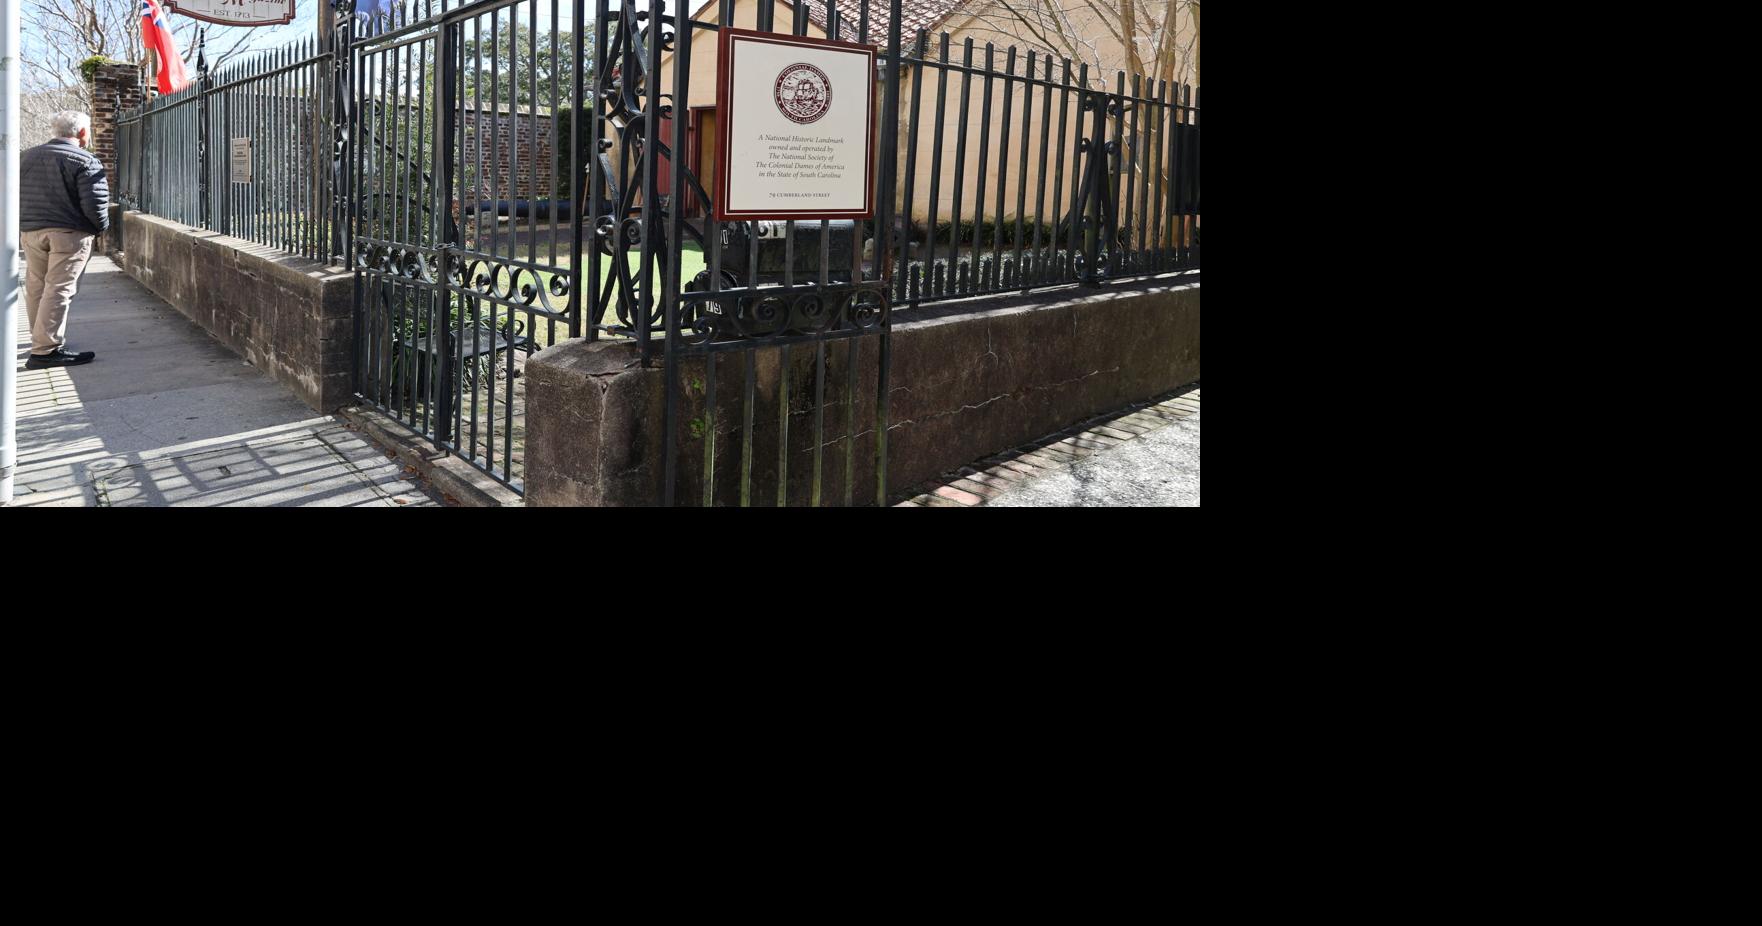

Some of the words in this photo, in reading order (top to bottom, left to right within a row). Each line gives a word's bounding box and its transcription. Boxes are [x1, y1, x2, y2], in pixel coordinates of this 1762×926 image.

[765, 134, 791, 142] National
[791, 135, 814, 143] Historic
[815, 136, 844, 144] Landmark
[789, 144, 801, 152] and
[801, 145, 826, 153] operated
[807, 154, 827, 162] Society
[814, 163, 822, 171] of
[792, 171, 799, 179] of
